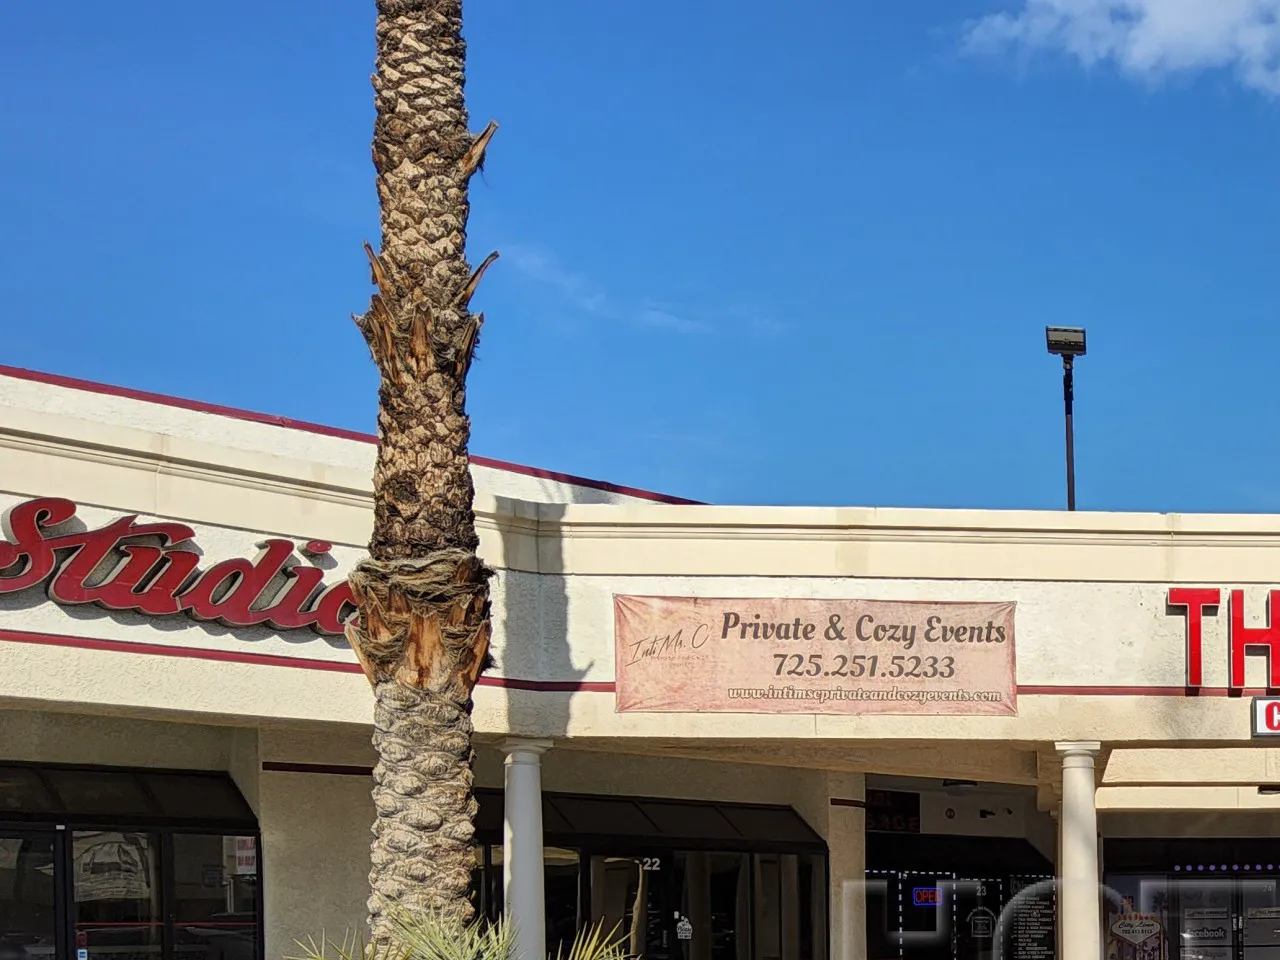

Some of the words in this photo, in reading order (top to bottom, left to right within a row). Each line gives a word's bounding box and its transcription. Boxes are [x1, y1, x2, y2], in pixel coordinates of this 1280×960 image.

[720, 610, 816, 643] Private
[823, 613, 847, 642] &
[855, 614, 917, 650] Cozy
[924, 616, 1007, 644] Events
[772, 653, 956, 679] 725.251.5233
[727, 685, 1003, 706] www.intimscprivateandcozyevents.com
[642, 857, 661, 871] 22
[915, 889, 942, 903] OPEN
[976, 886, 987, 897] 23
